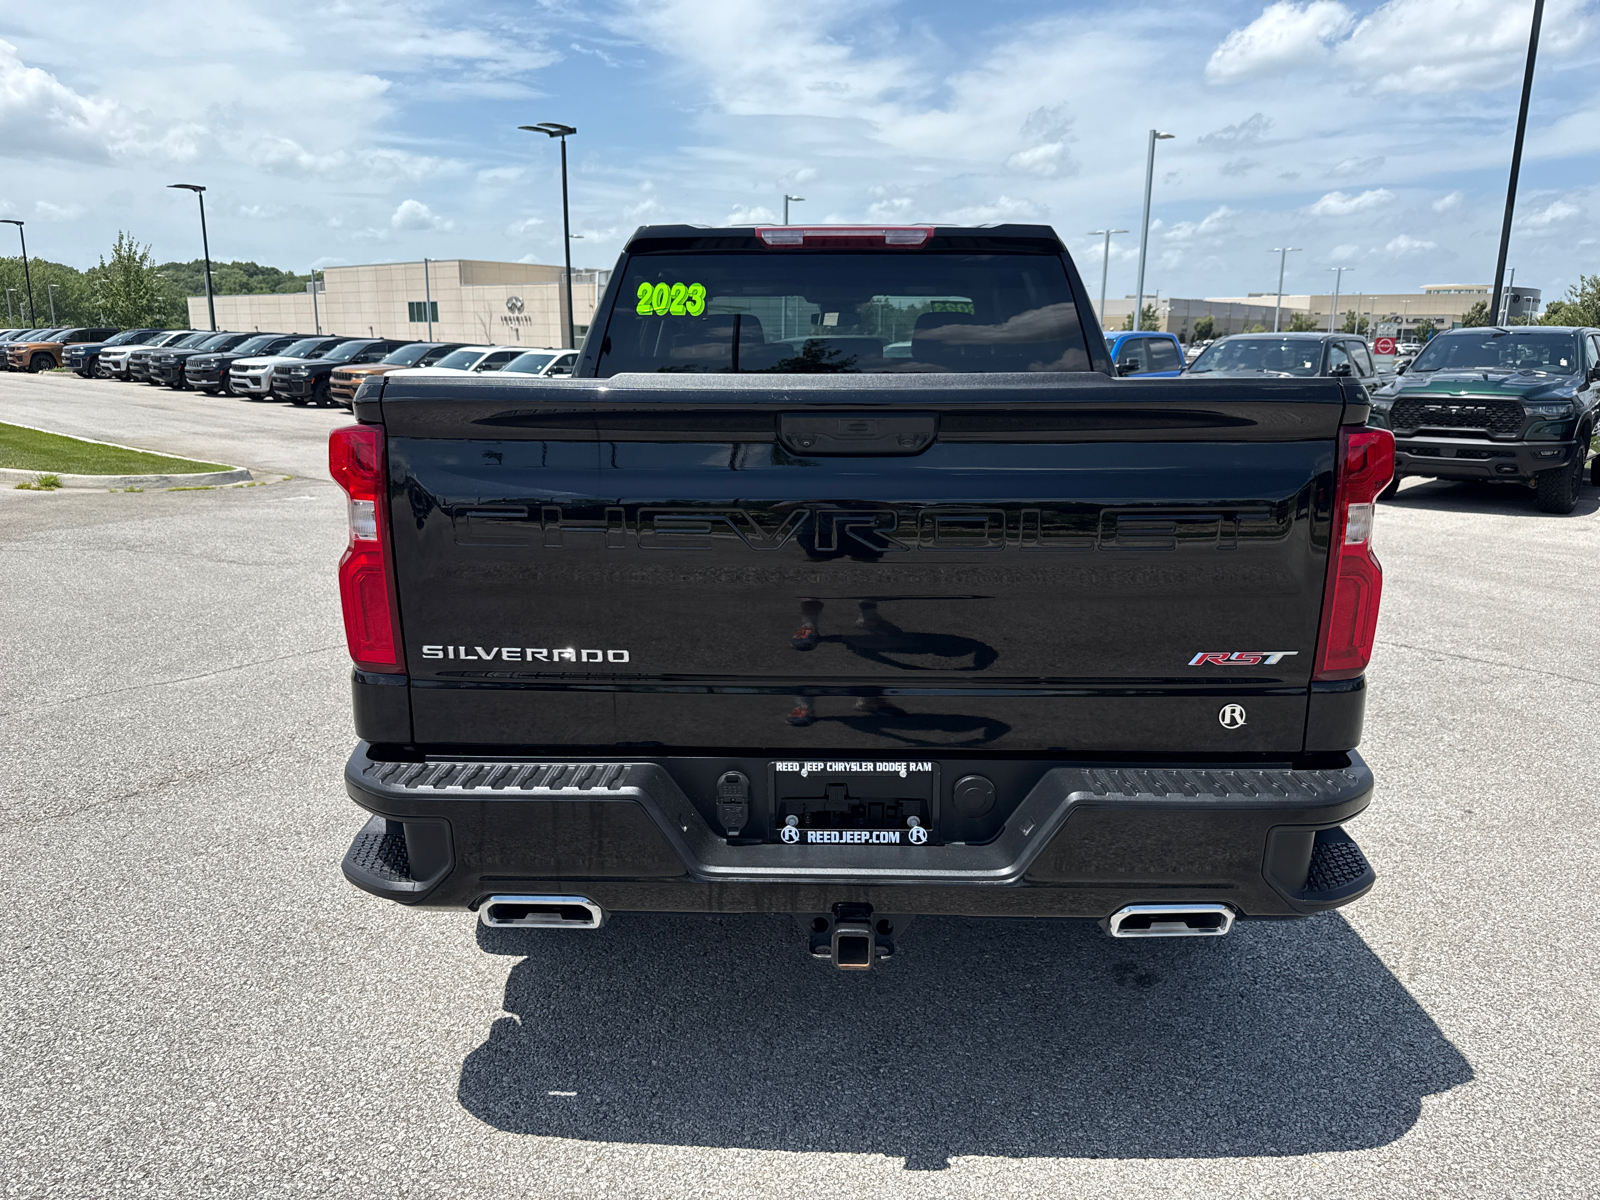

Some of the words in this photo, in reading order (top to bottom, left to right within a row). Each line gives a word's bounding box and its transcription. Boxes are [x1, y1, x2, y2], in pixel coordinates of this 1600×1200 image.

[636, 282, 707, 317] 2023
[451, 504, 1273, 552] CHEVROLET
[422, 645, 630, 663] SILVERADO
[1188, 651, 1299, 666] RST
[776, 762, 800, 772] REED
[801, 762, 825, 772] JEEP
[826, 762, 874, 772] CHRYSLER
[876, 763, 907, 772] DODGE
[909, 763, 932, 772] RAM
[807, 831, 900, 844] REEDJEEP.COM
